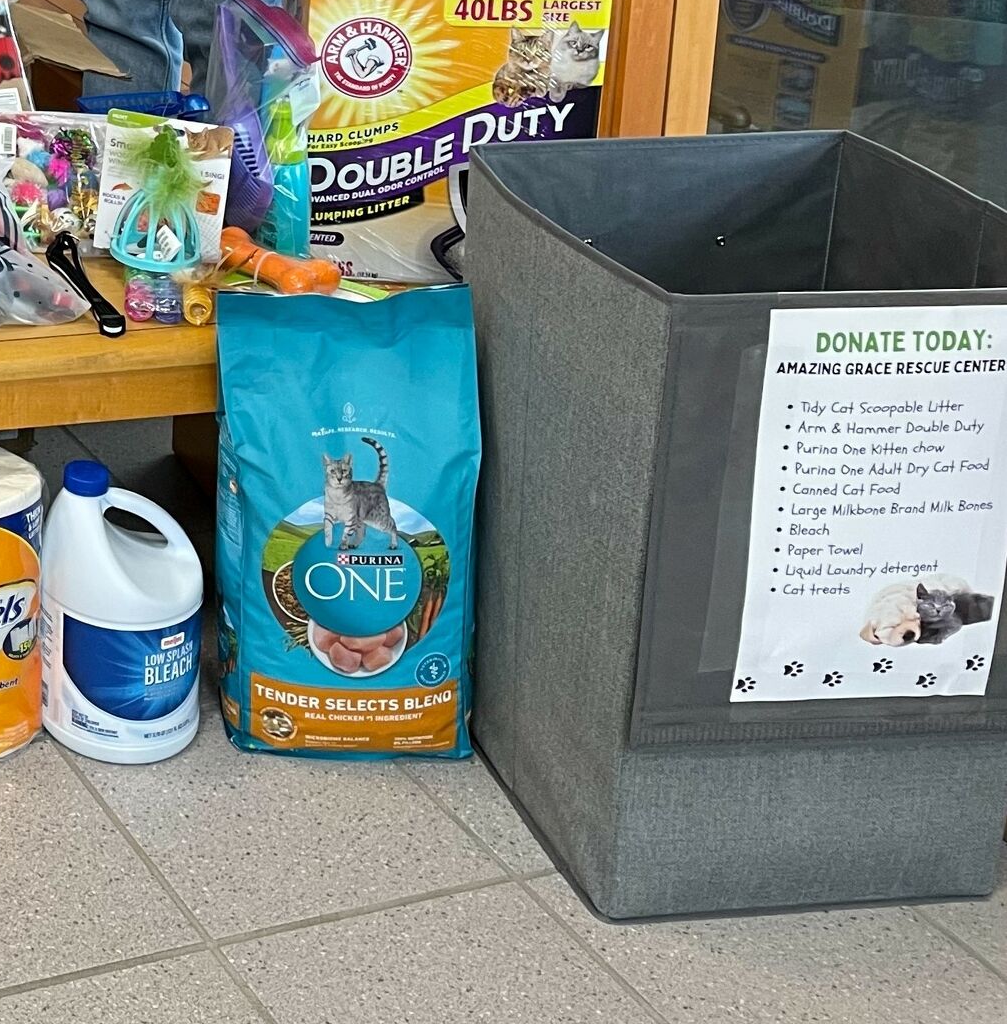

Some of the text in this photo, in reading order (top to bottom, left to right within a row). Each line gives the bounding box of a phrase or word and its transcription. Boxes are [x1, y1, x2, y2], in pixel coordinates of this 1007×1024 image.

[543, 0, 602, 10] LARGEST
[543, 12, 570, 22] SIZE
[326, 22, 407, 66] ARM & HAMMER
[307, 122, 399, 143] HARD CLUMPS
[462, 103, 576, 155] DUTY
[321, 142, 338, 150] Easy
[309, 133, 454, 193] DOUBLE
[352, 166, 445, 200] DUAL ODOR CONTROL
[367, 195, 410, 215] LITTER
[816, 329, 993, 353] DONATE TODAY:
[777, 359, 1006, 375] AMAZING GRACE RESCUE CENTER
[800, 400, 964, 417] Tidy Cat Scoopable Litter
[798, 419, 985, 435] Arm & Hammer Double Duty
[796, 441, 945, 455] Purina One Kitten chow
[795, 459, 990, 478] Purina One Adult Dry Cat Food
[793, 482, 901, 496] Canned Cat Food
[791, 498, 994, 520] Large Milkbone Brand Milk Bones
[789, 524, 831, 536] Bleach
[351, 555, 403, 565] PURINA
[787, 543, 863, 559] Paper Towel
[785, 560, 939, 580] Liquid Laundry detergent
[304, 562, 407, 602] ONE
[783, 583, 851, 596] Cat treats
[145, 640, 193, 667] LOW SPLASH
[144, 653, 193, 686] BLEACH
[255, 683, 453, 712] TENDER SELECTS BLEND
[305, 712, 327, 721] REAL
[328, 714, 365, 722] CHICKEN
[375, 712, 424, 722] INGREDIENT
